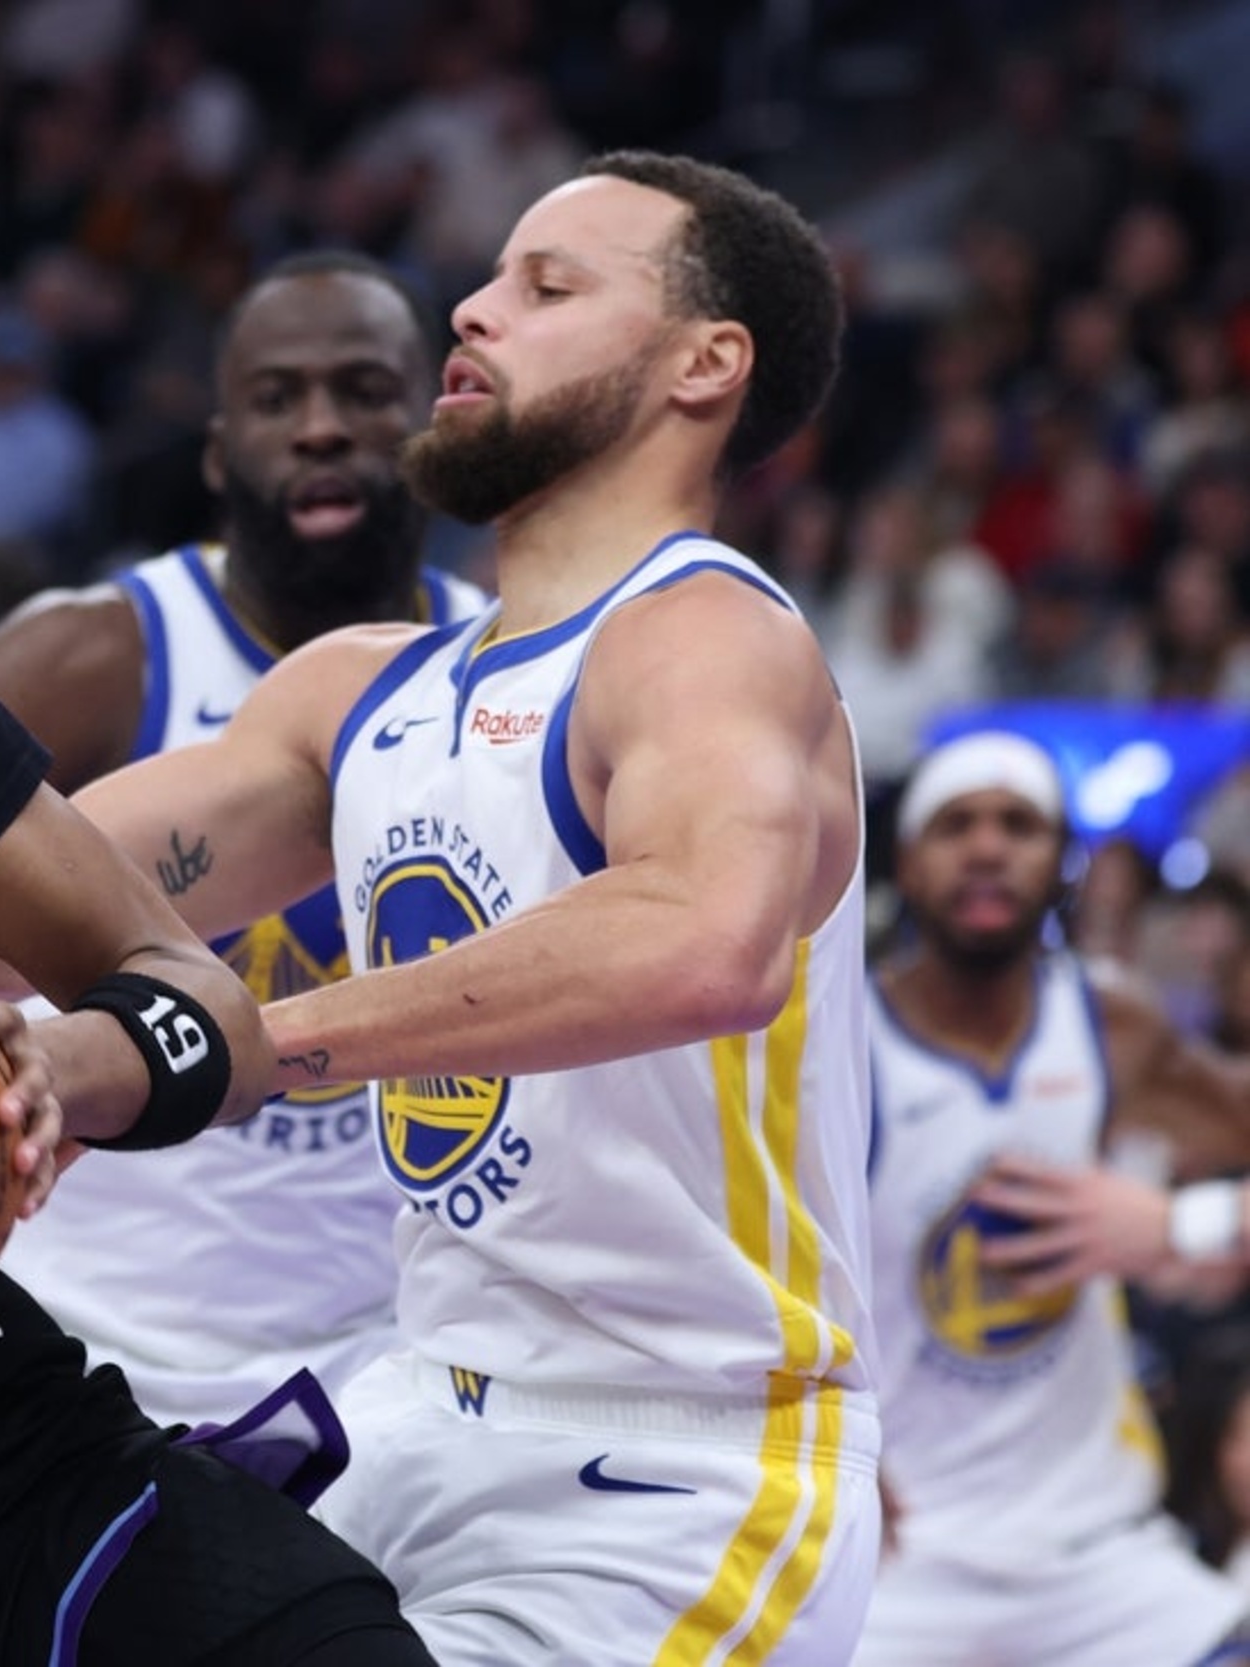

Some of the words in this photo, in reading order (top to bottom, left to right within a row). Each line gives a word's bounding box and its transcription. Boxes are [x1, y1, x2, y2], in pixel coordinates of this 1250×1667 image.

[471, 708, 543, 745] Rakute
[354, 816, 444, 913] GOLDEN
[448, 824, 513, 919] STATE
[138, 994, 209, 1074] 19
